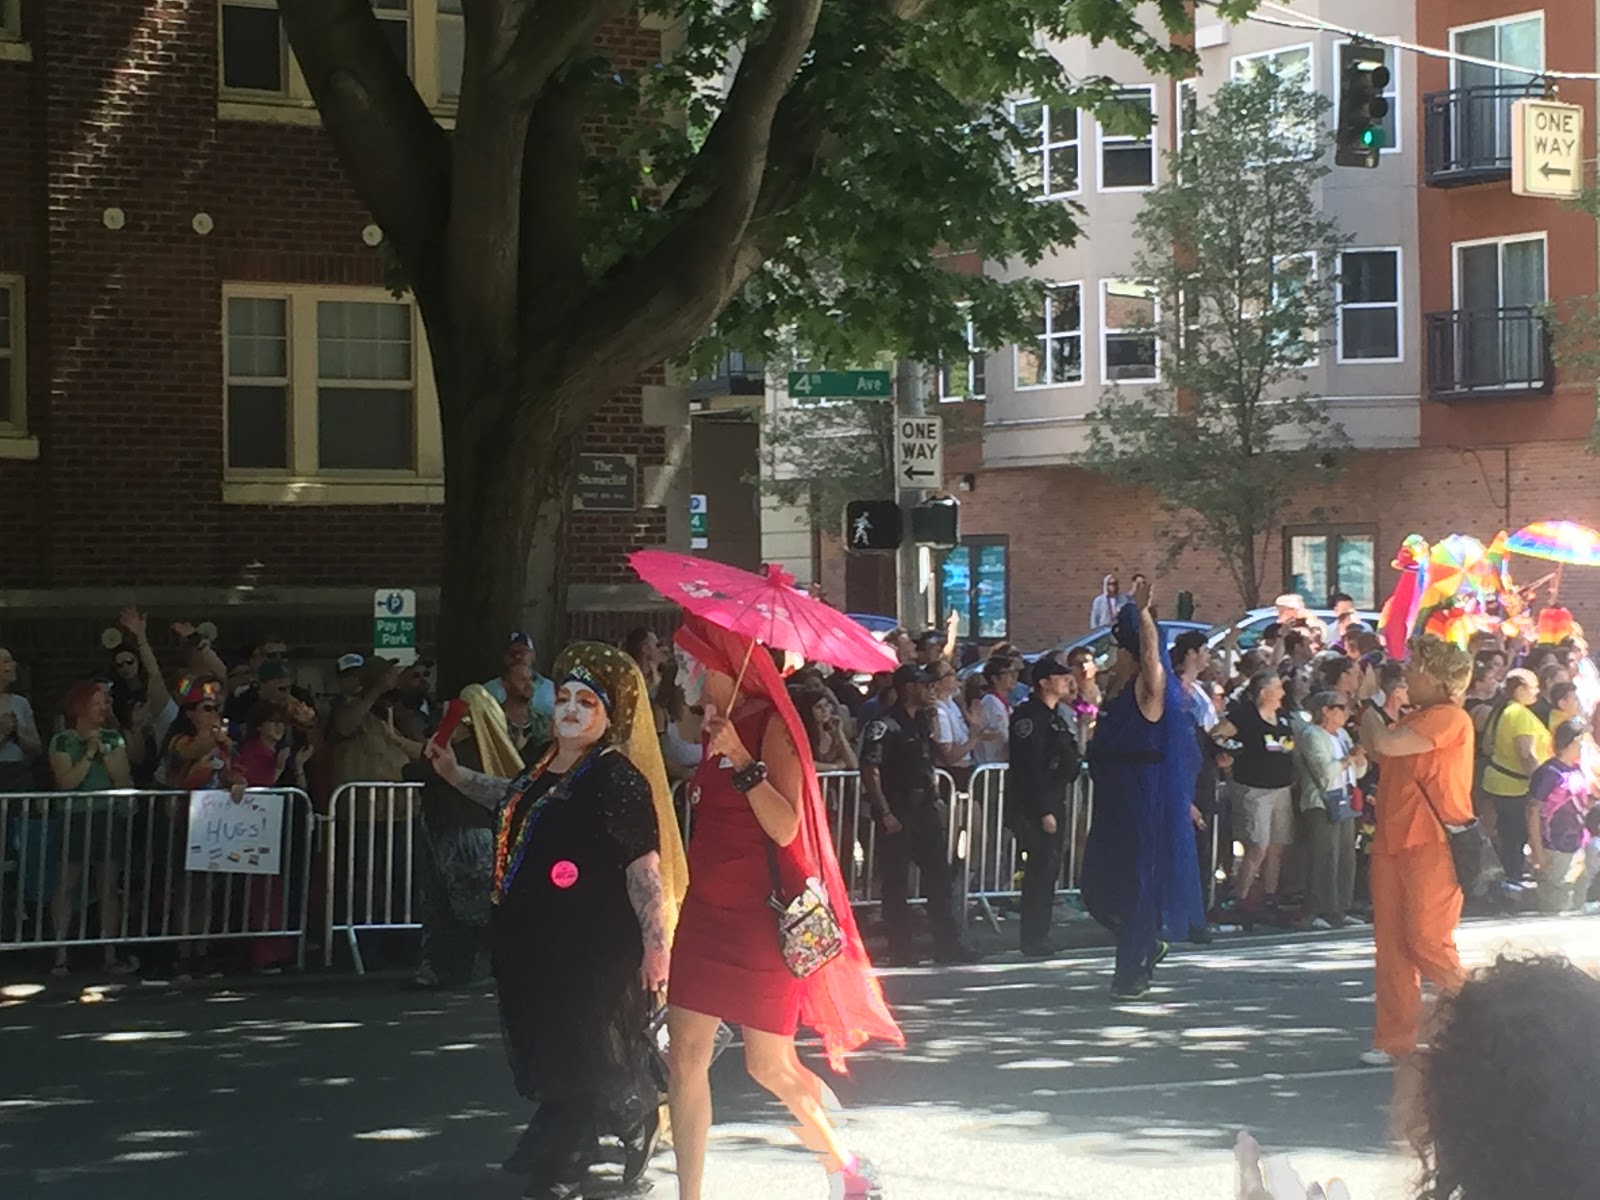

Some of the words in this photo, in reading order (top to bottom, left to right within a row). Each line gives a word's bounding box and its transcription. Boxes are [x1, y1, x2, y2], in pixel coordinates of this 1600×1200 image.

[1535, 111, 1573, 133] ONE
[1534, 135, 1575, 157] WAY
[856, 376, 882, 391] Ave
[901, 422, 937, 439] ONE
[901, 442, 938, 460] WAY
[592, 460, 614, 472] The
[377, 619, 398, 633] Pay
[400, 620, 414, 632] to
[382, 633, 409, 645] Park
[206, 818, 267, 843] HUGS!
